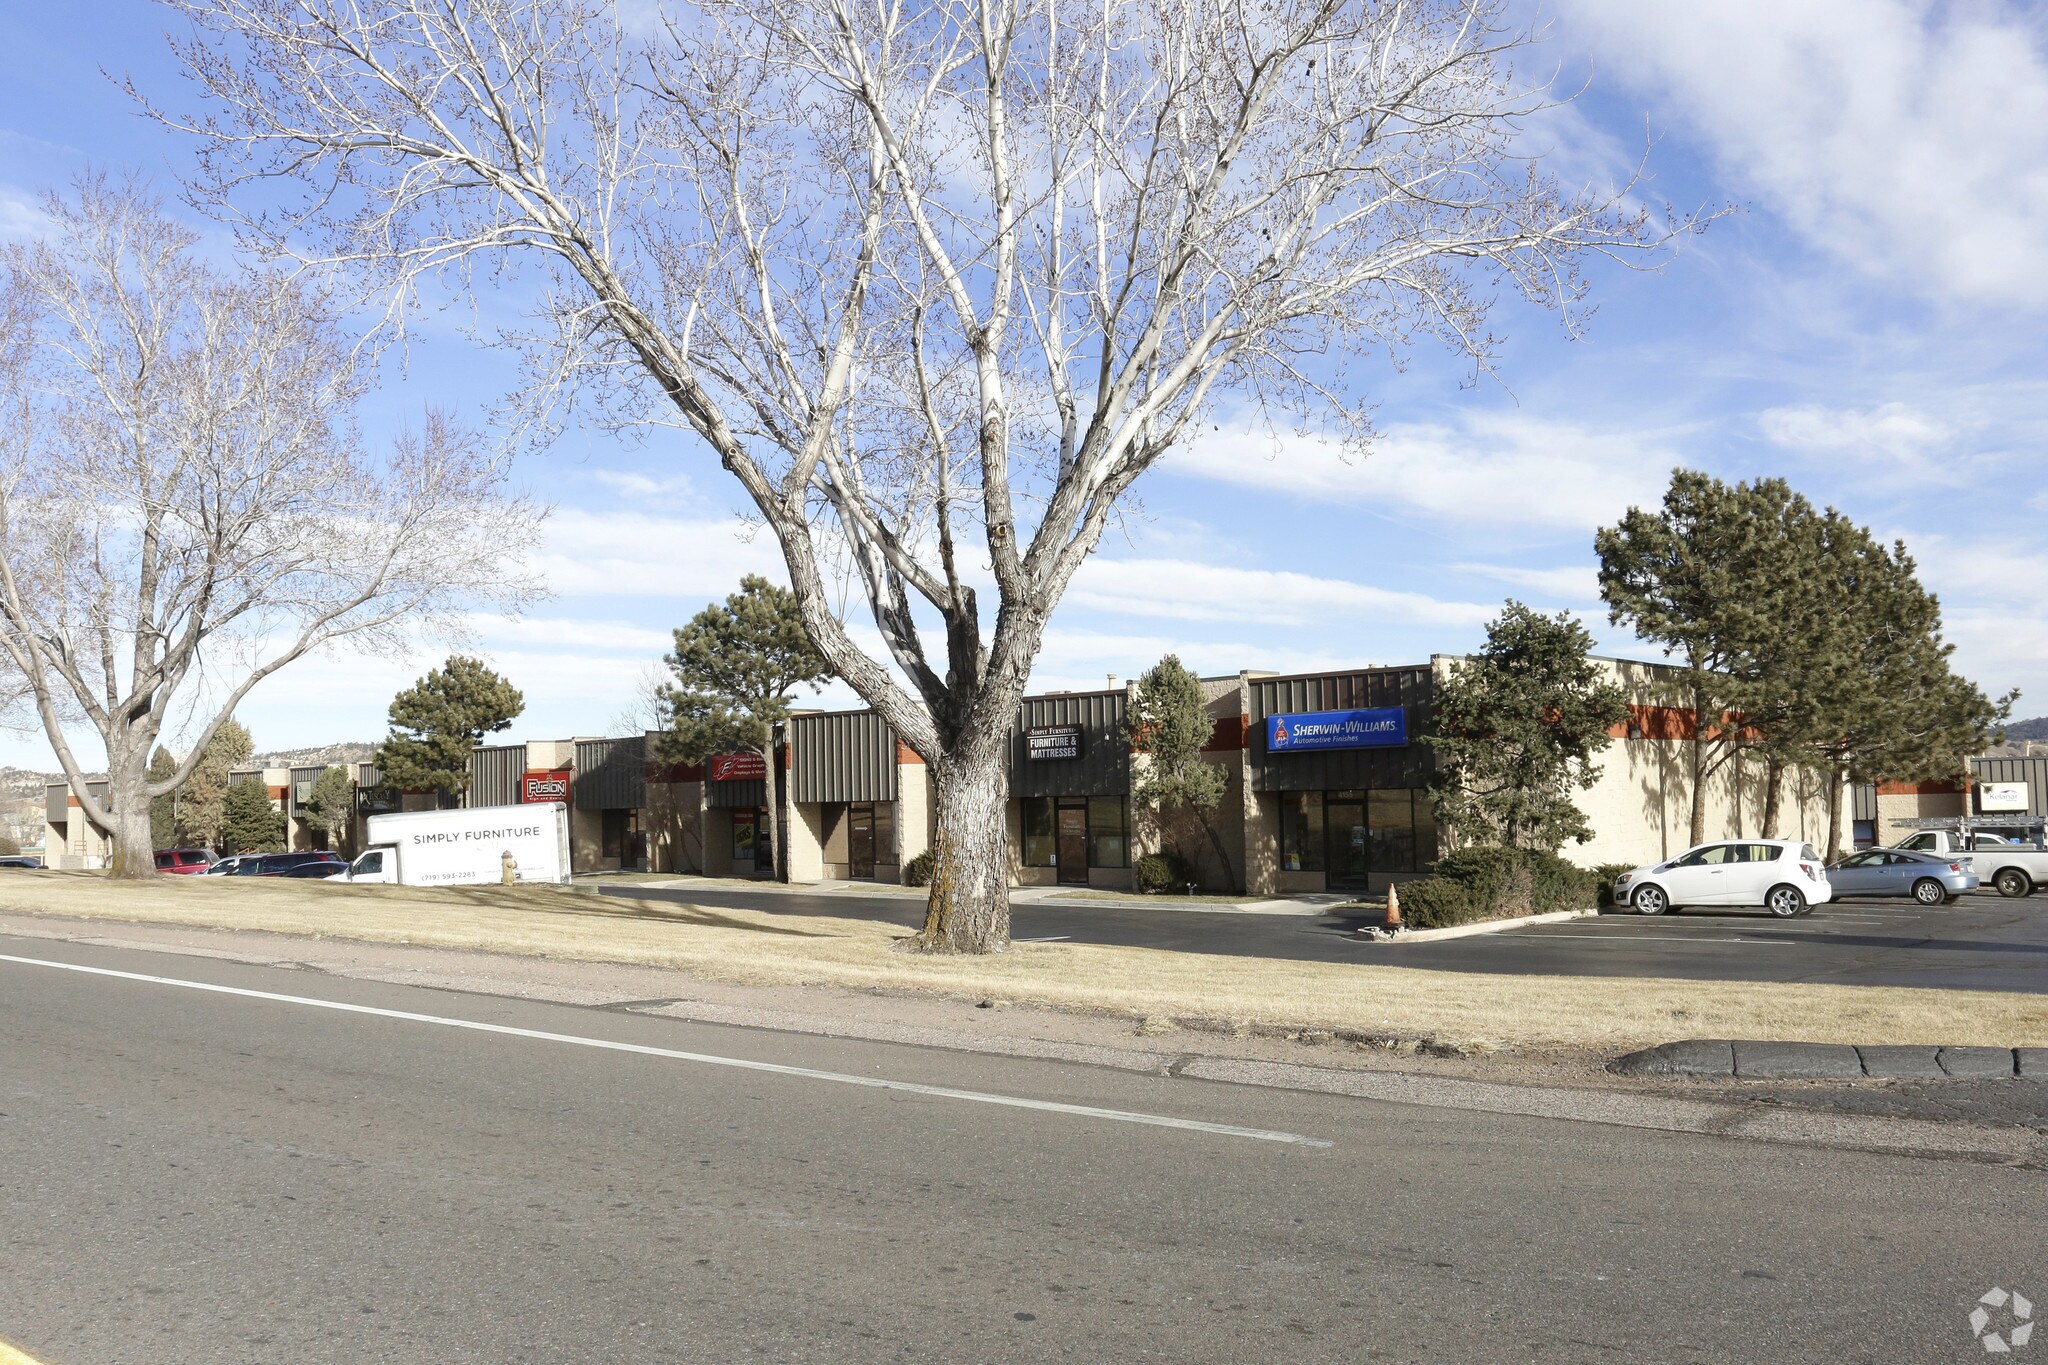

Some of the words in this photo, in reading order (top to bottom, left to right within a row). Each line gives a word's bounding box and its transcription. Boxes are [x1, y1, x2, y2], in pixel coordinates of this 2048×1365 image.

[1293, 720, 1396, 736] SHERWIN-WILLIAMS
[1030, 737, 1069, 748] FURNITURE
[1070, 736, 1077, 746] &
[1293, 736, 1331, 745] Automotive
[1332, 734, 1358, 743] Finishes
[1031, 748, 1077, 758] MATTRESSES
[414, 832, 460, 845] SIMPLY
[465, 826, 541, 841] FURNITURE
[421, 872, 440, 881] (719)
[442, 871, 476, 880] 593-2283
